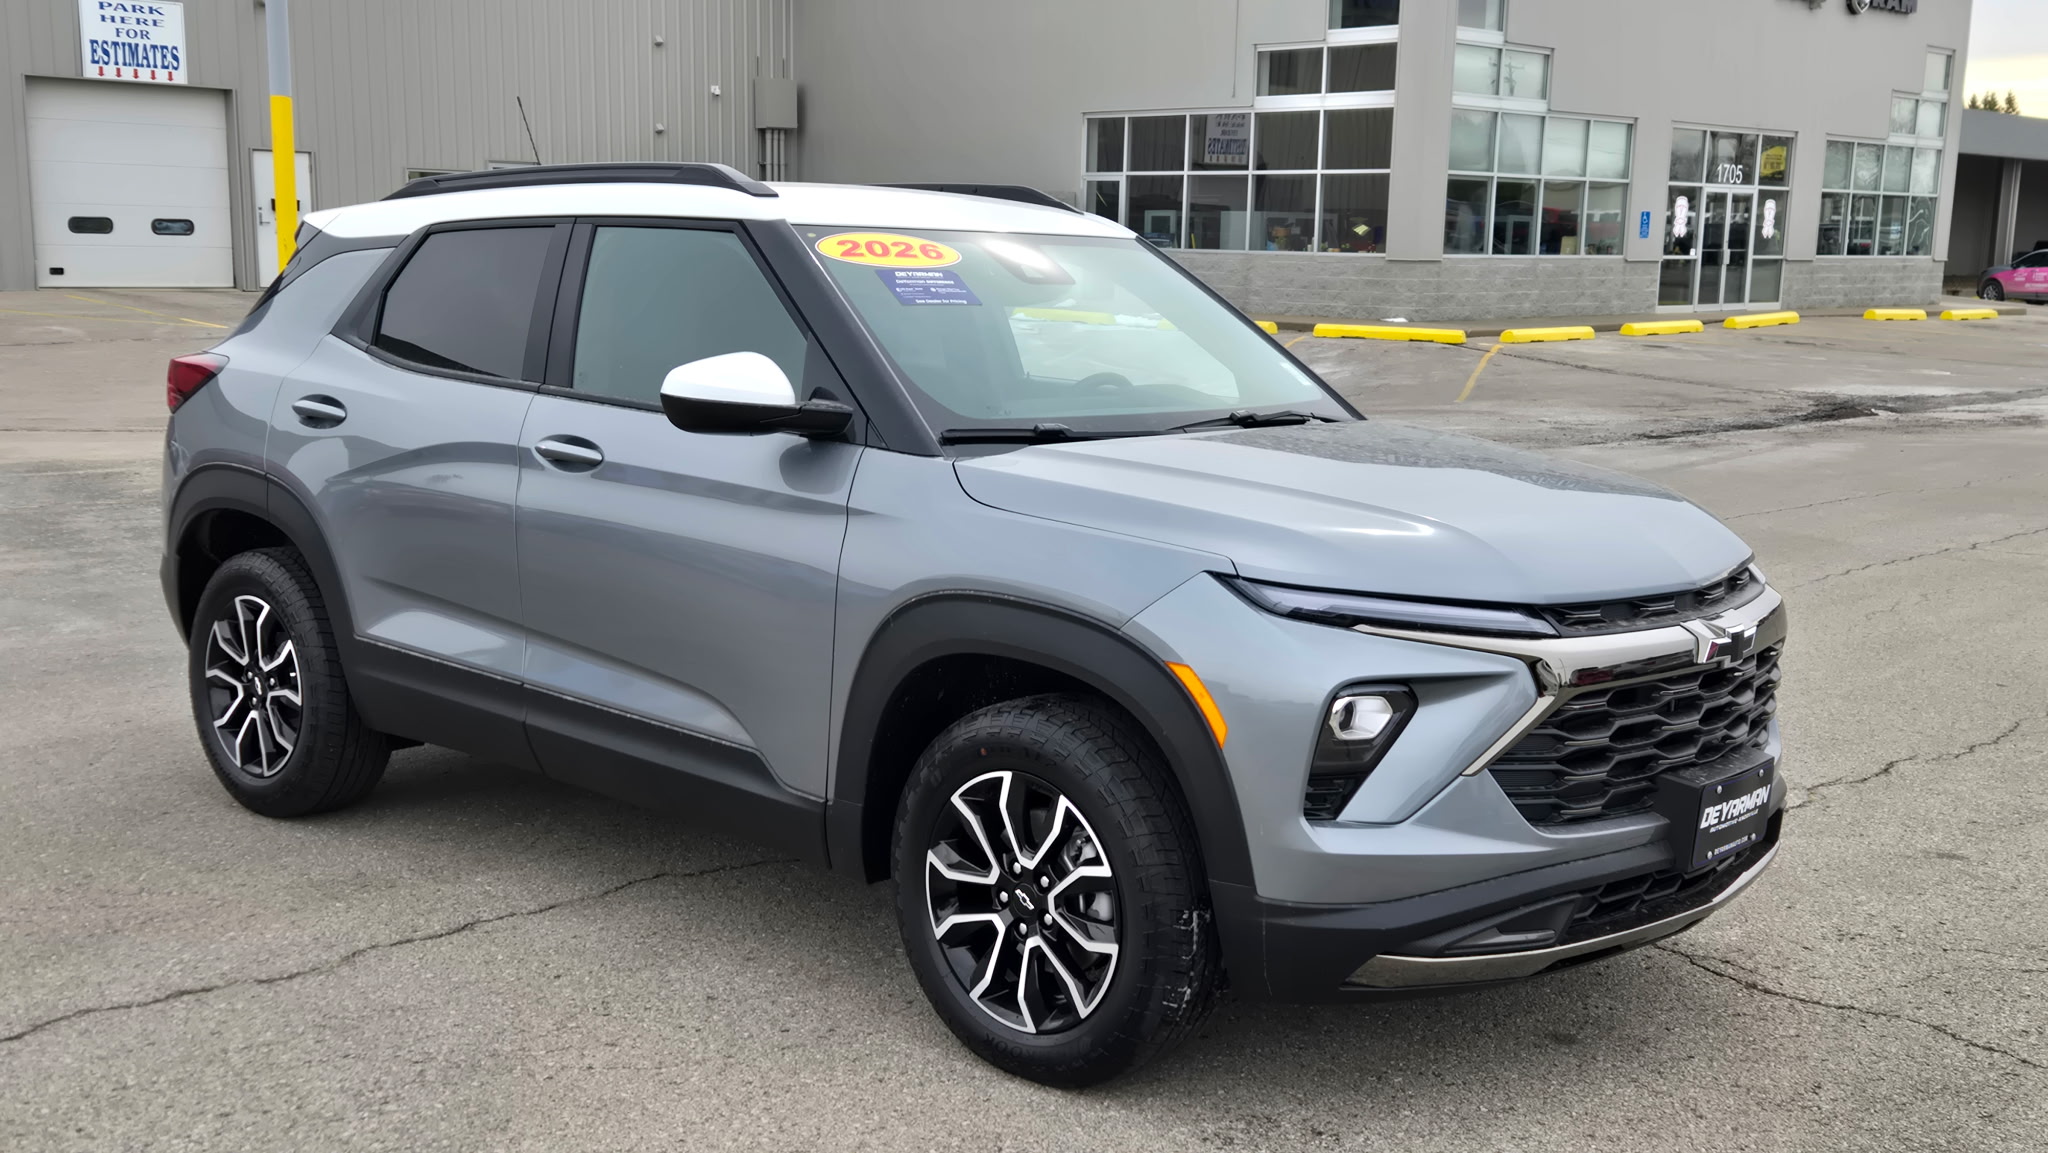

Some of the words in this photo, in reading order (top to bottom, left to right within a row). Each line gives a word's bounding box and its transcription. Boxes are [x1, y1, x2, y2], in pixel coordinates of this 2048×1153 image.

[98, 1, 165, 16] PARK
[100, 14, 165, 27] HERE
[115, 27, 151, 40] FOR
[89, 39, 180, 71] ESTIMATES
[1717, 163, 1743, 184] 1705
[837, 239, 946, 260] 2026
[1700, 784, 1771, 829] DEYARMAN
